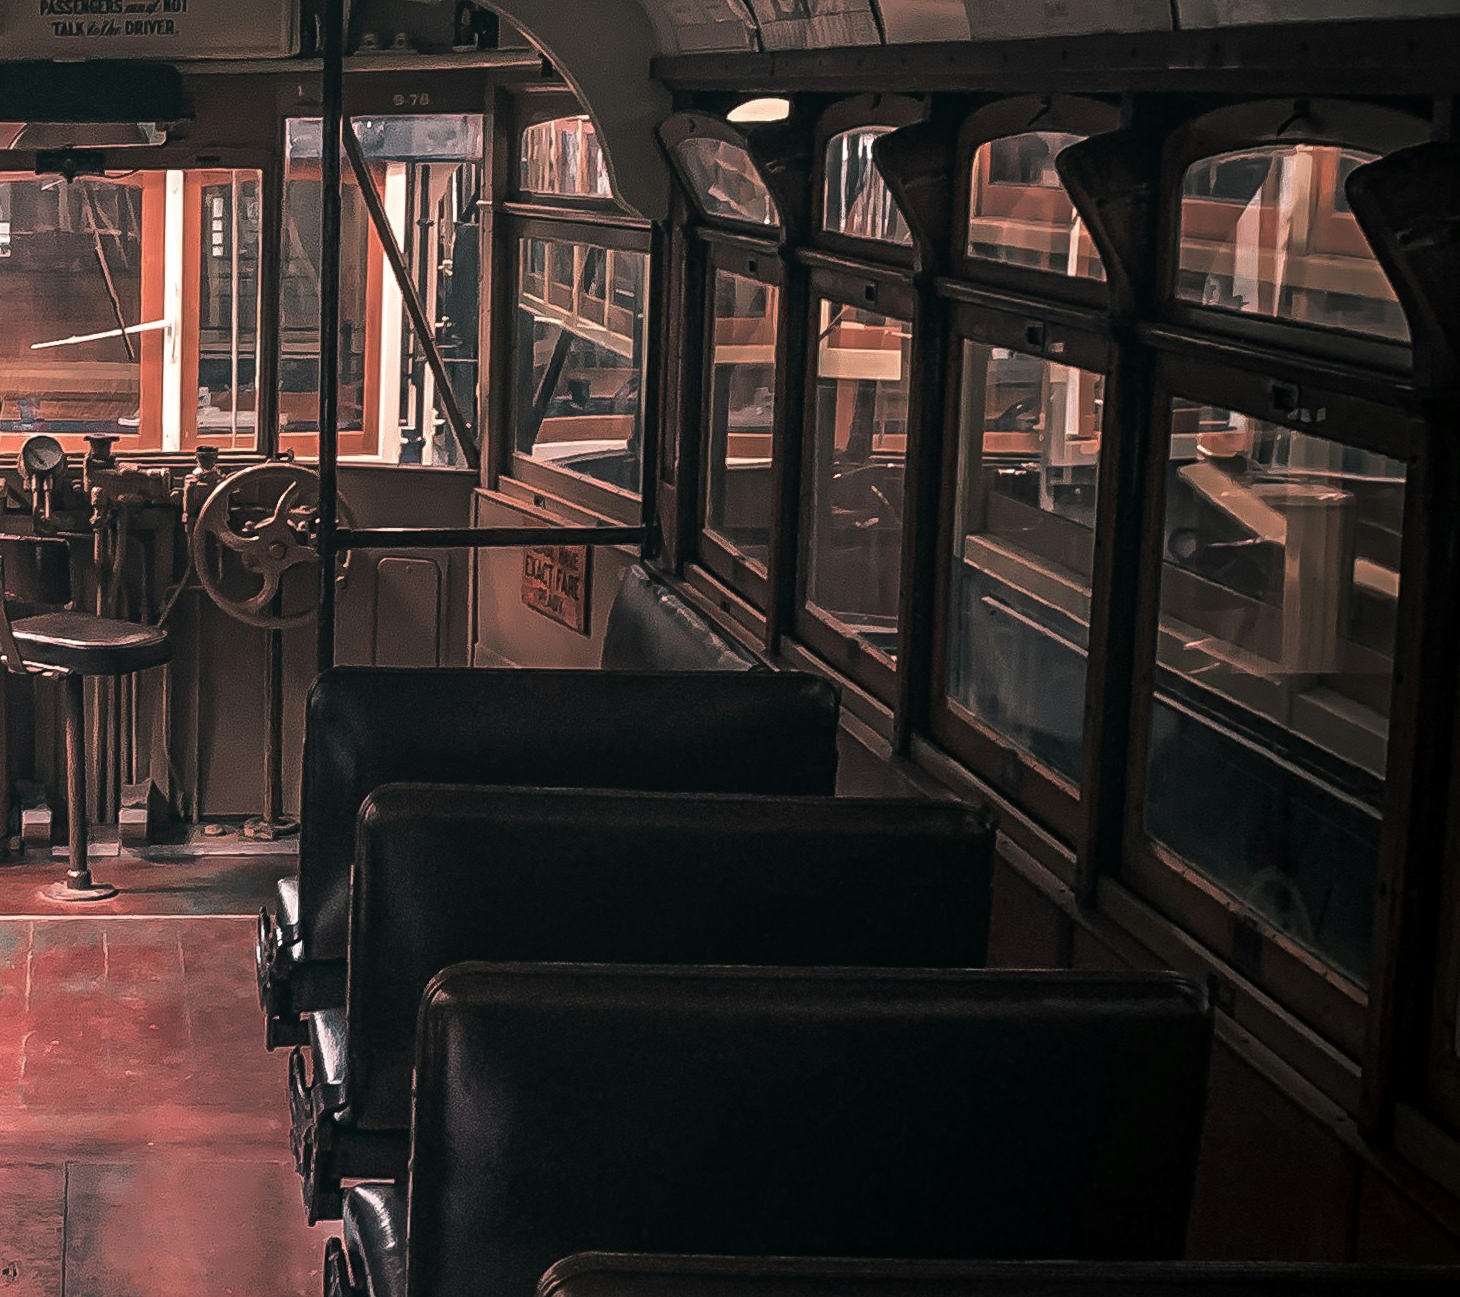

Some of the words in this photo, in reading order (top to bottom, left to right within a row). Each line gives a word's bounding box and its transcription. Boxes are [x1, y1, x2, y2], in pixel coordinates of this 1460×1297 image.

[51, 20, 85, 36] TALK
[526, 555, 553, 590] EXACT
[556, 569, 580, 601] FARE
